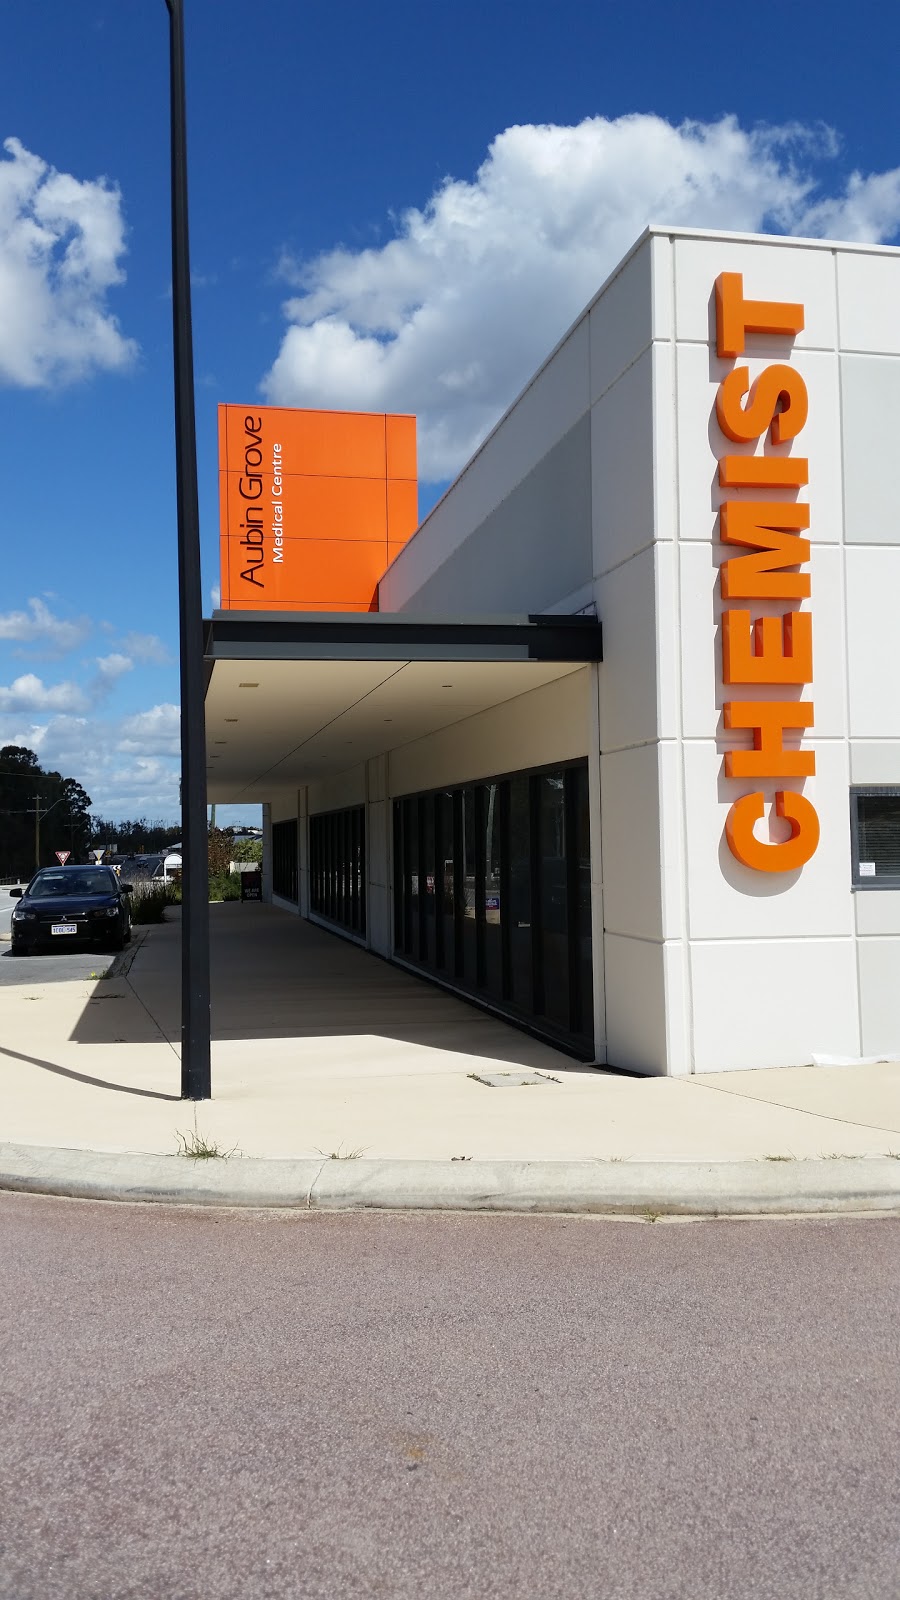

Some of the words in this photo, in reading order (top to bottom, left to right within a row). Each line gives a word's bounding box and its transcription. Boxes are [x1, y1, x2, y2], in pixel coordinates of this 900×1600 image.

[238, 415, 263, 500] Grove
[271, 443, 283, 497] Centre
[239, 506, 265, 589] Aubin
[271, 501, 284, 564] Medical
[715, 271, 820, 873] CHEMIST
